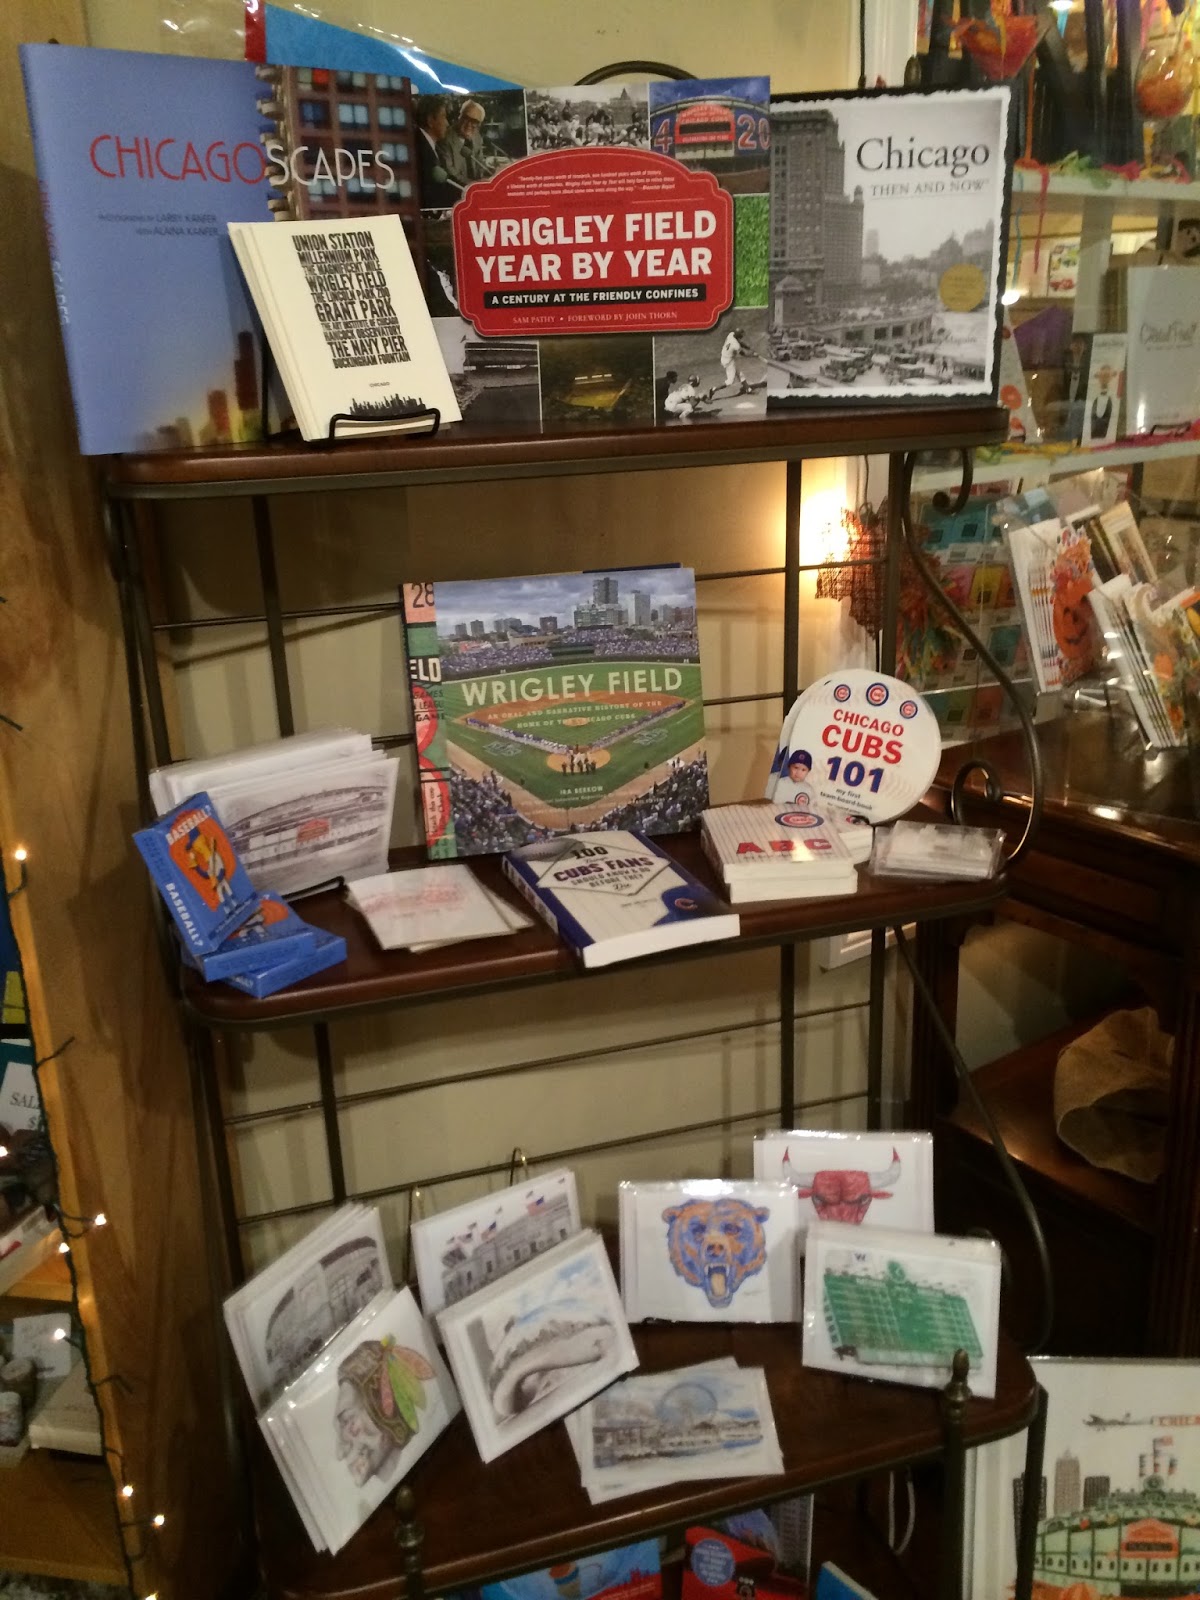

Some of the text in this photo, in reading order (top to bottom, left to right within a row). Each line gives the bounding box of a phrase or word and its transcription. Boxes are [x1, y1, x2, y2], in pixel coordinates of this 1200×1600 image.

[90, 134, 395, 190] CHICAGOSCAPES
[856, 136, 990, 178] Chicago
[871, 183, 909, 197] THEN
[915, 181, 945, 194] AND
[468, 210, 717, 248] WRIGLEY FIELD
[292, 231, 374, 251] UNION STATION
[297, 248, 380, 265] MILLENNIUM PARK
[475, 247, 713, 284] YEAR BY YEAR
[318, 262, 364, 276] MAGNIFICENT
[365, 260, 382, 272] MILE
[305, 271, 387, 293] WRIGLEY FIELD
[311, 287, 391, 304] THE LINCOLN PARK ZOO
[492, 288, 700, 306] A CENTURY AT THE FRIENDLY CONFINES
[314, 298, 397, 322] GRANT PARK
[512, 310, 678, 324] SAM PATHY FOREWORD BY JOHN THORN
[356, 325, 402, 338] OBSERVATORY
[327, 336, 408, 358] THE NAVY PIER
[332, 351, 412, 369] BUCKINGHAM FOUNTAIN
[412, 583, 436, 608] 28
[461, 668, 682, 707] WRIGLEY FIELD
[546, 706, 592, 716] NARRATIVE
[594, 703, 630, 712] HISTORY
[517, 720, 540, 729] HOME
[833, 708, 904, 737] CHICAGO
[822, 724, 904, 765] CUBS
[826, 756, 885, 794] 101
[574, 786, 604, 794] BERKOW
[165, 804, 212, 846] BASEBALL?
[570, 846, 609, 860] 100
[553, 857, 656, 882] CUBS FANS
[570, 874, 605, 886] SHOULD
[606, 868, 631, 878] KNOW
[588, 873, 644, 888] BEFORE THEY
[165, 882, 204, 947] BASEBALL?
[9, 1092, 41, 1109] SAL
